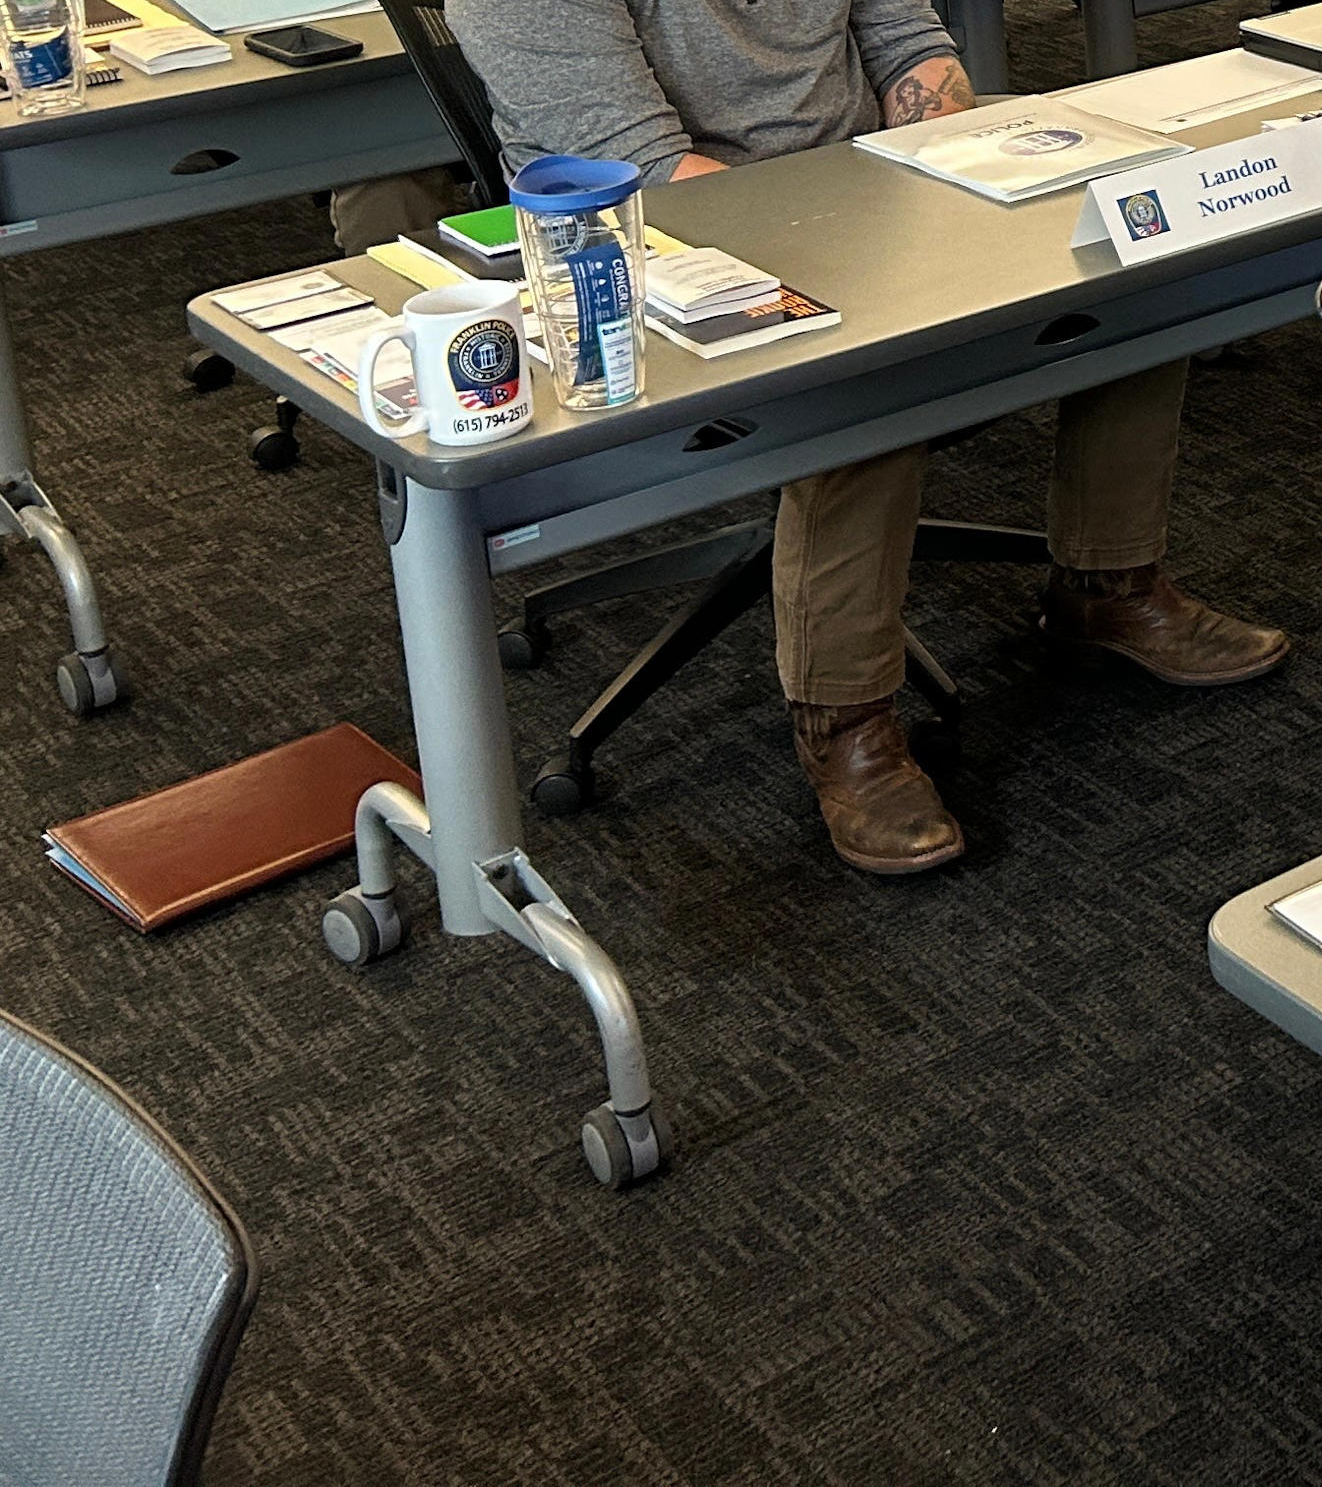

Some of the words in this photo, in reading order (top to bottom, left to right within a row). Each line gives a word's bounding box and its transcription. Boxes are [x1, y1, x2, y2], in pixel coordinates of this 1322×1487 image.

[1198, 156, 1279, 190] Landon
[1197, 175, 1293, 218] Norwood
[449, 321, 492, 353] FRANKLIN
[453, 416, 483, 434] (615)
[485, 402, 529, 429] 794-2513
